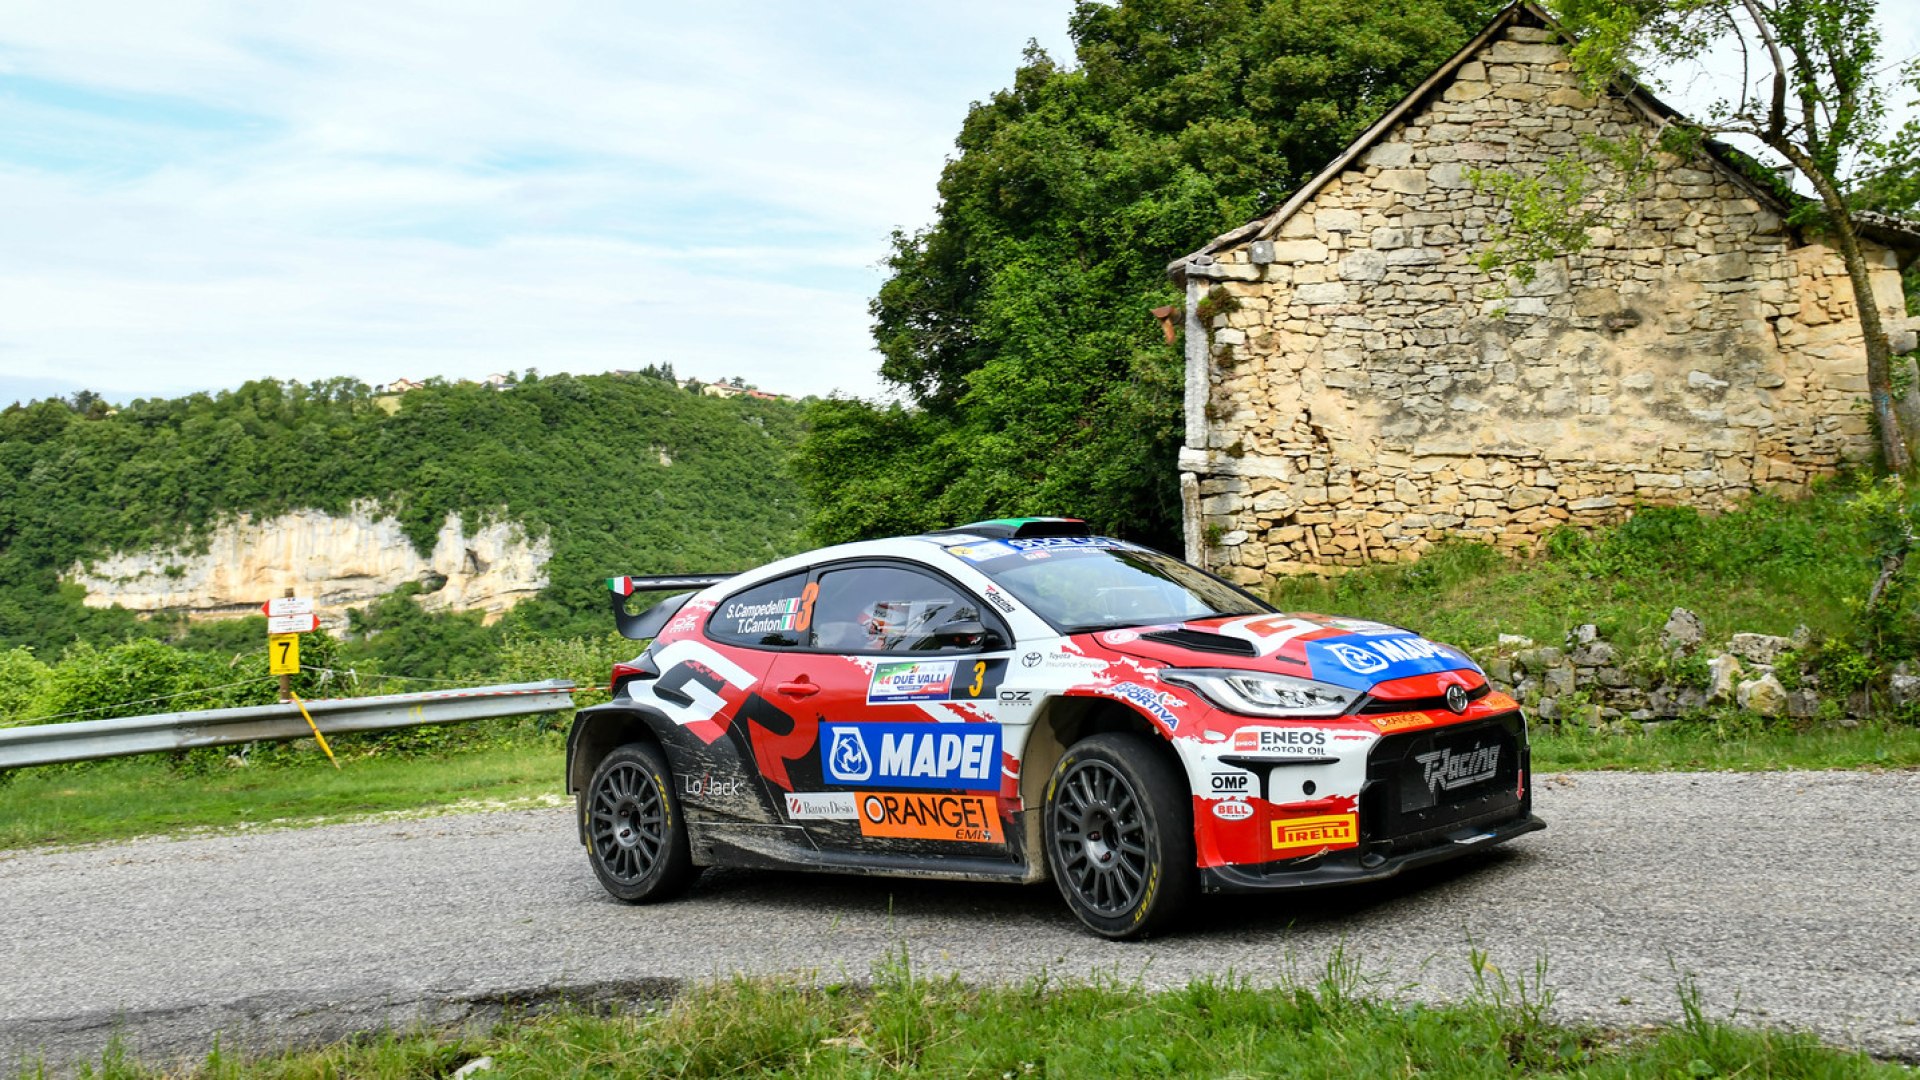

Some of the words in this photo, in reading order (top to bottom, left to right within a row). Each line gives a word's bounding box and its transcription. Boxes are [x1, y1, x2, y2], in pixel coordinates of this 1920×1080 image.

[795, 582, 820, 632] 3
[278, 642, 290, 664] 7
[1049, 652, 1071, 660] Toyota
[893, 676, 915, 685] DUE
[917, 674, 946, 683] VALLI
[968, 661, 986, 697] 3
[1000, 691, 1032, 700] OZ
[1260, 731, 1326, 745] ENEOS
[879, 733, 995, 780] MAPEI
[1260, 746, 1304, 754] MOTOR
[1307, 747, 1326, 755] OIL
[1211, 776, 1248, 789] OMP
[803, 801, 829, 814] Banco
[830, 801, 854, 814] Desio
[1218, 805, 1248, 814] BELL
[1277, 820, 1350, 843] PIRELLI
